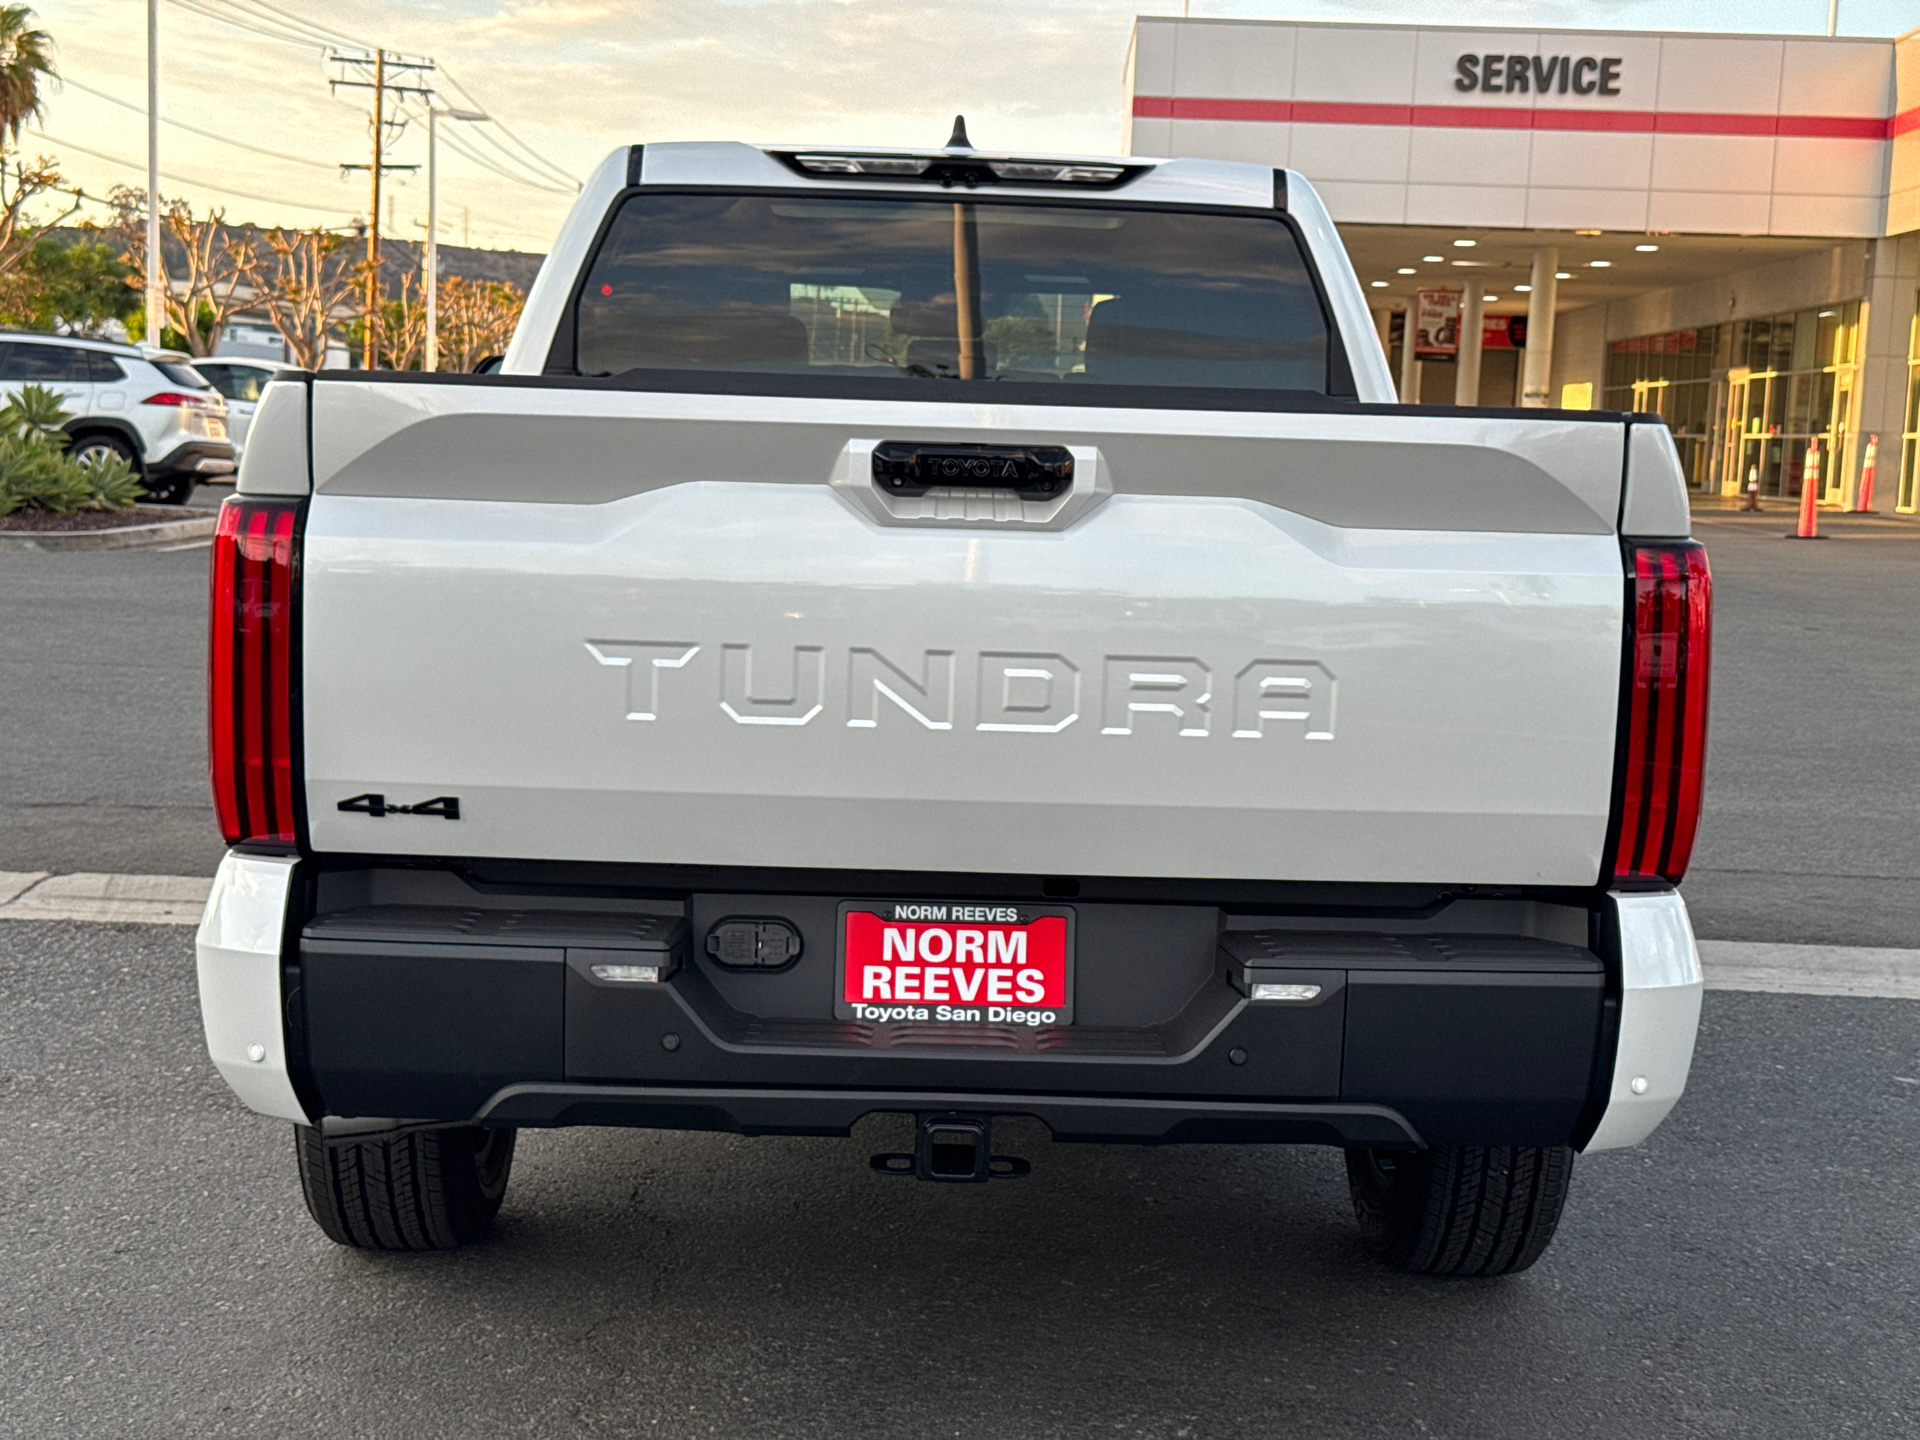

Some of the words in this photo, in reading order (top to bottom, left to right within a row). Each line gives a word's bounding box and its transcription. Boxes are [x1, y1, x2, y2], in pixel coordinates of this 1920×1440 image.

[1455, 54, 1622, 95] SERVICE
[928, 458, 1019, 478] TOYOTA
[584, 640, 1338, 740] TUNDRA
[895, 905, 947, 920] NORM
[952, 906, 1018, 922] REEVES
[883, 928, 1027, 964] NORM
[863, 965, 1045, 1003] REEVES
[851, 1003, 929, 1023] Toyota
[935, 1005, 980, 1022] San
[988, 1006, 1056, 1026] Diego
